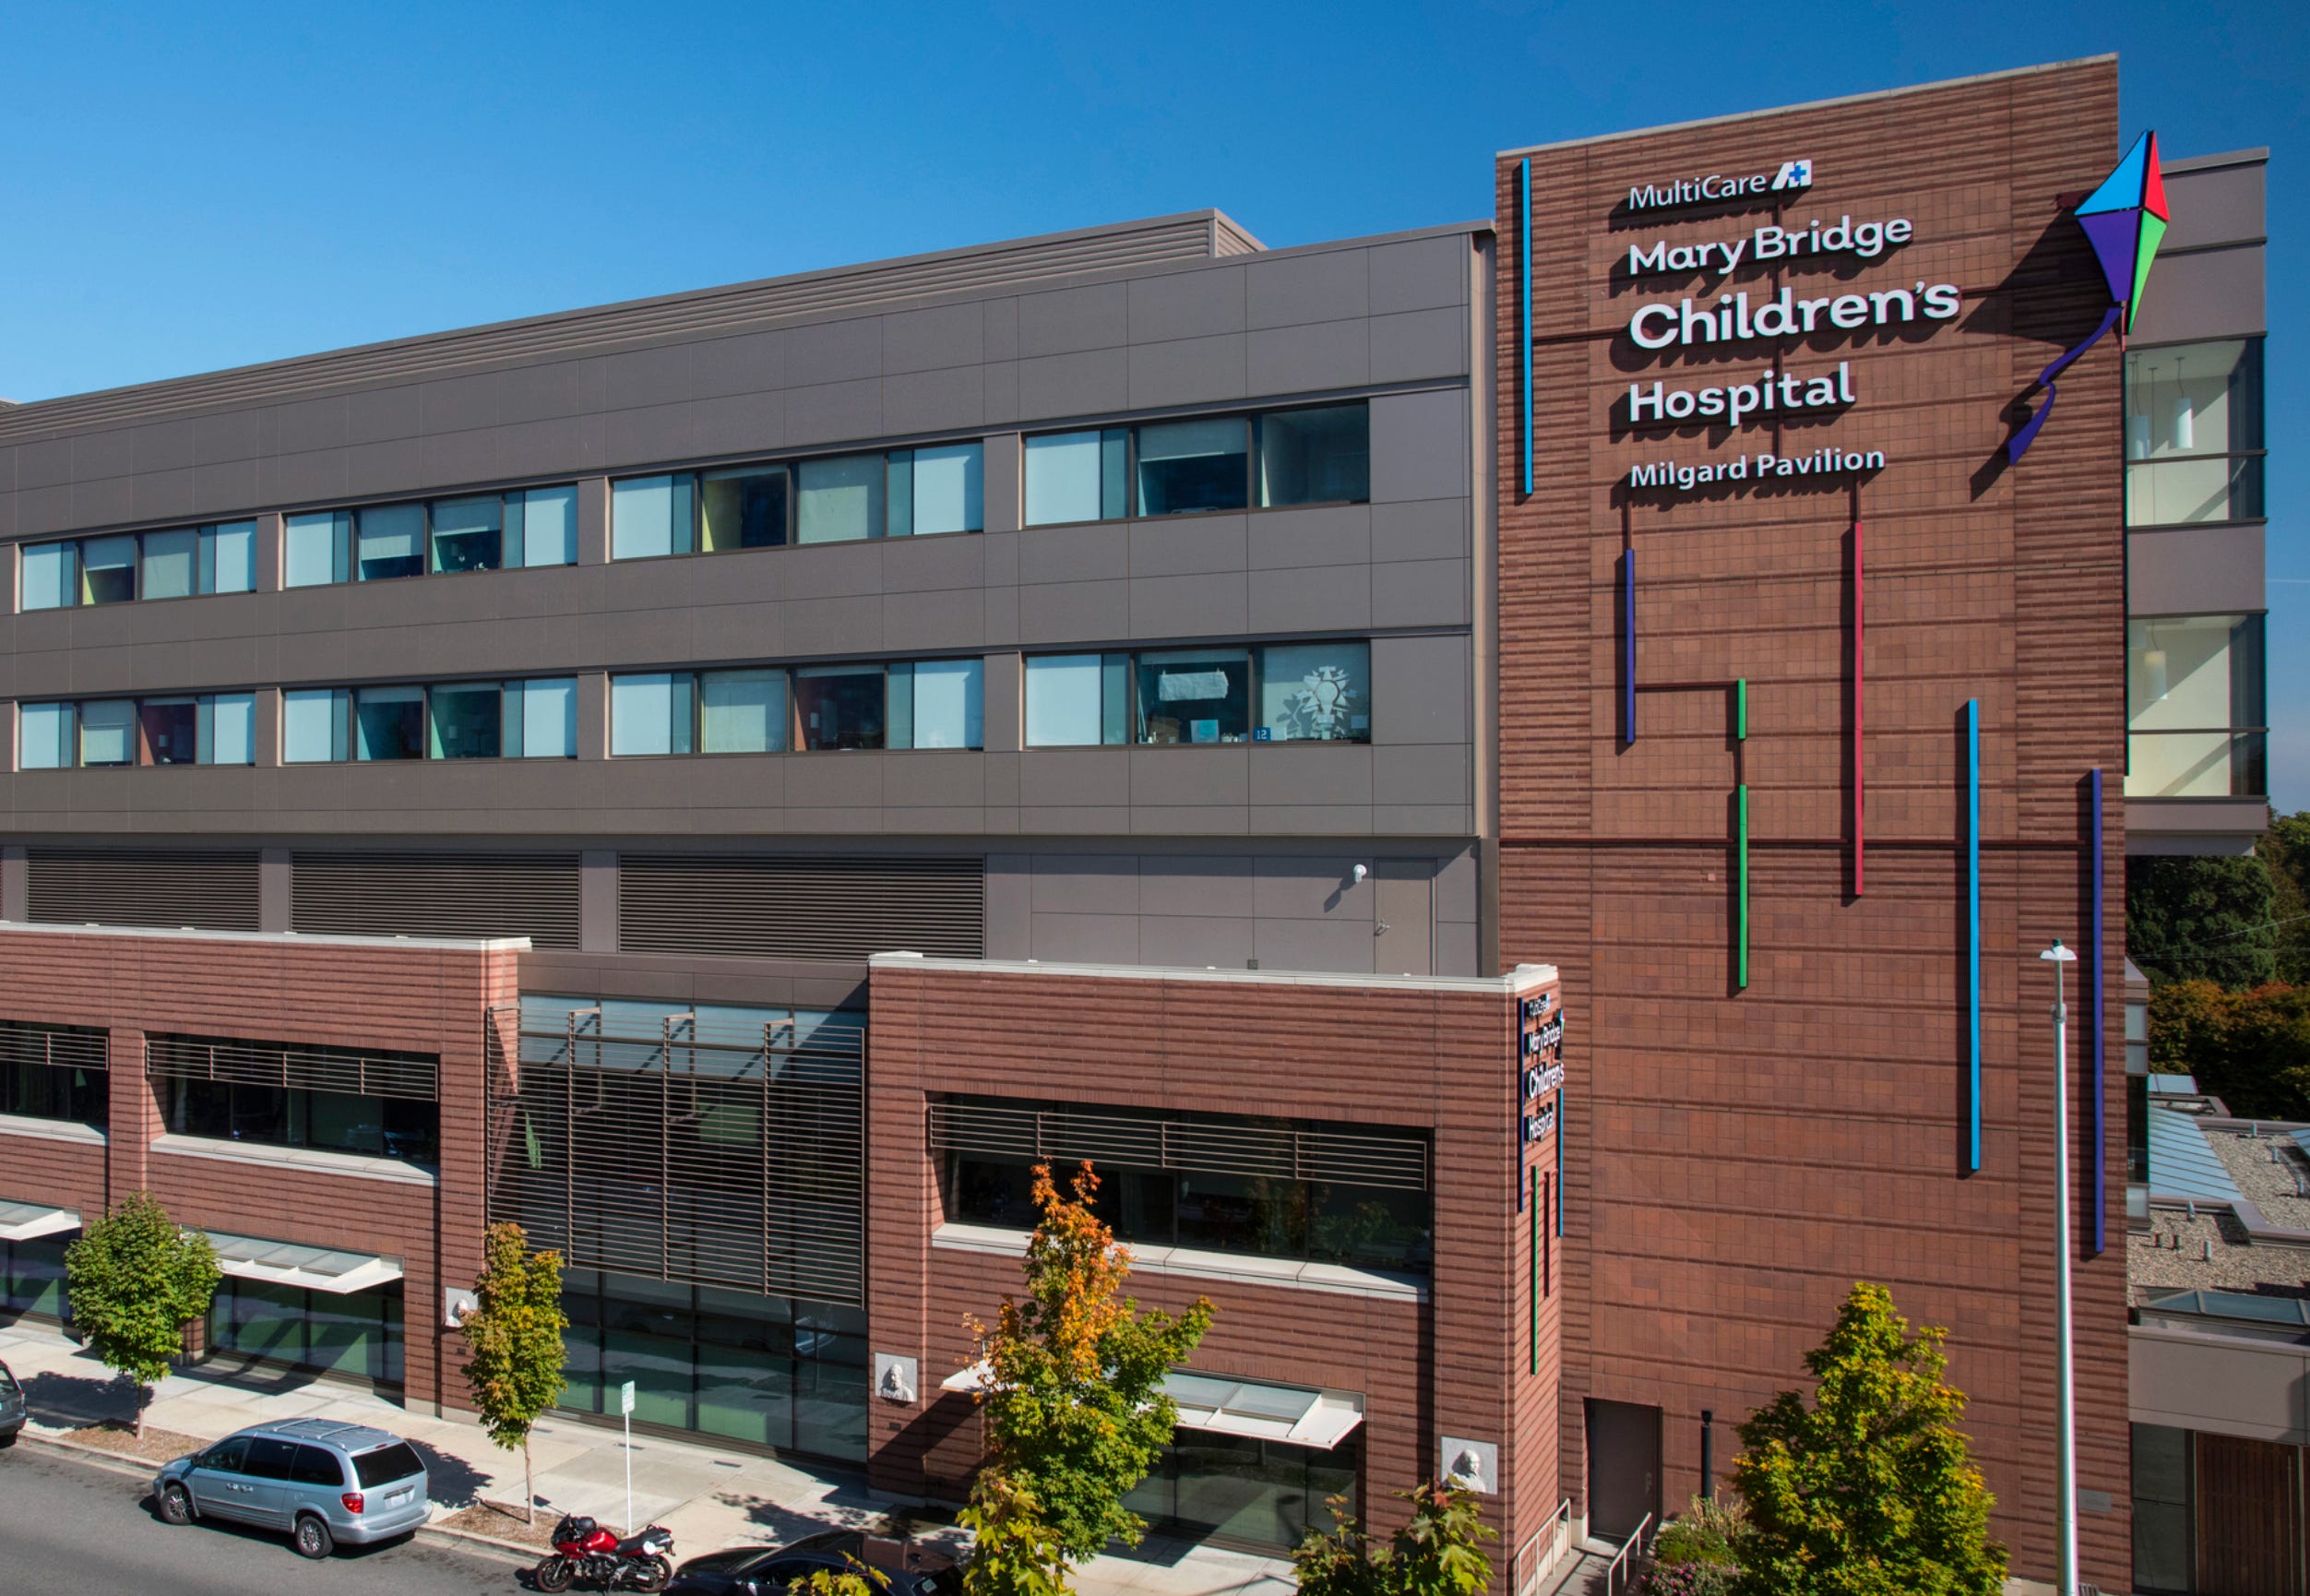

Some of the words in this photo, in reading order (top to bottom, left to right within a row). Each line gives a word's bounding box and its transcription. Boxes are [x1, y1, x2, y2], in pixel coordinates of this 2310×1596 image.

[1628, 173, 1767, 210] MultiCare
[1628, 239, 1746, 275] Mary
[1754, 214, 1914, 257] Bridge
[1629, 280, 1961, 350] Children's
[1629, 361, 1856, 426] Hospital
[1630, 455, 1748, 491] Milgard
[1756, 447, 1886, 480] Pavilion
